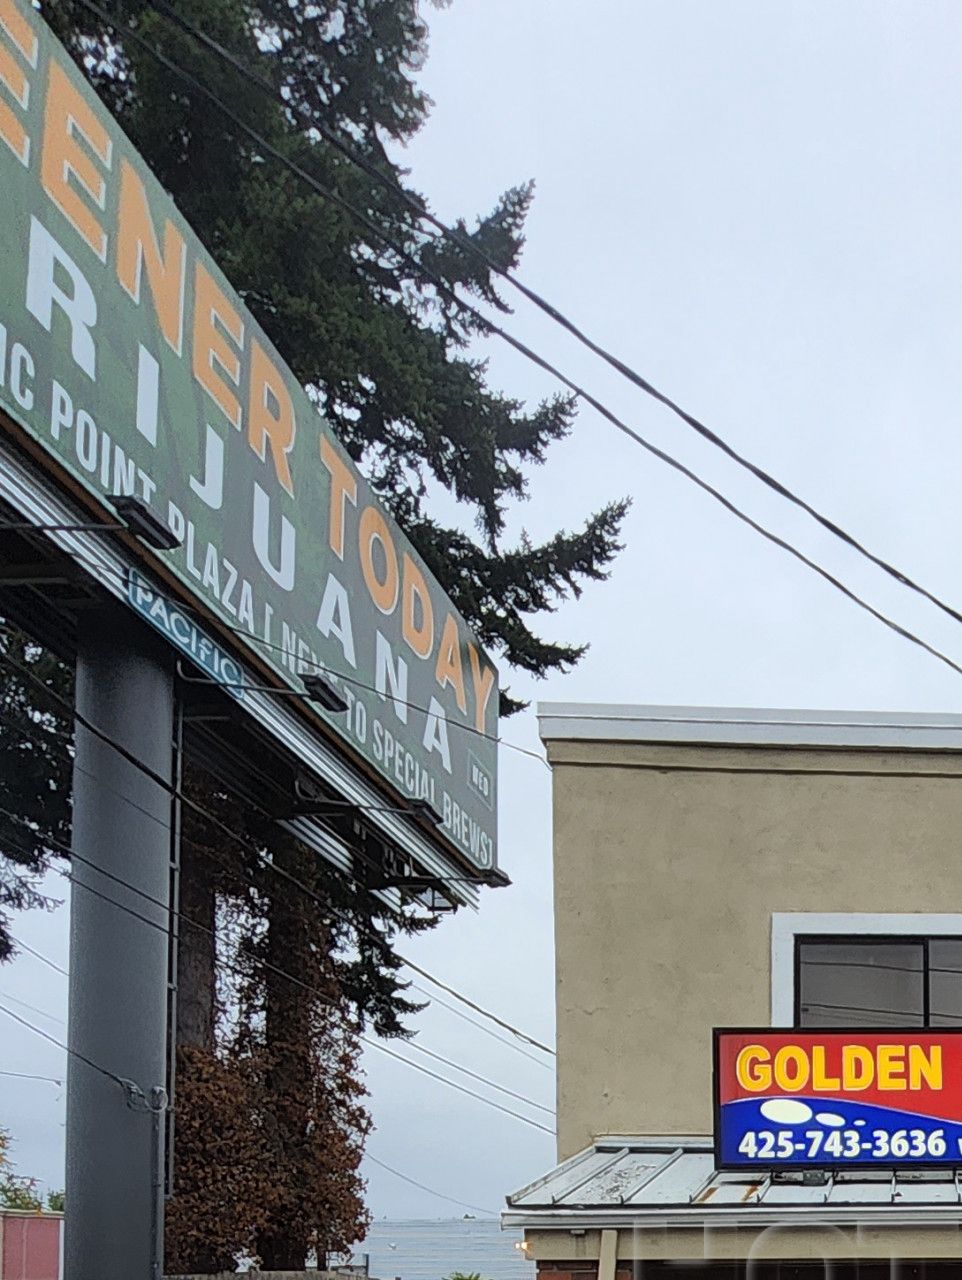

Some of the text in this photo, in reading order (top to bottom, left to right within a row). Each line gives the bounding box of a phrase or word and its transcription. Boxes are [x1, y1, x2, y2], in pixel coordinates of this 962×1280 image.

[51, 380, 157, 503] POINT
[168, 500, 255, 635] PLAZA
[281, 621, 338, 685] NE
[343, 685, 367, 744] TO
[372, 719, 436, 804] SPECIAL
[136, 576, 240, 687] PACIFIC
[319, 434, 496, 738] TODAY
[736, 1044, 943, 1093] GOLDEN
[738, 1129, 947, 1159] 425-743-3636
